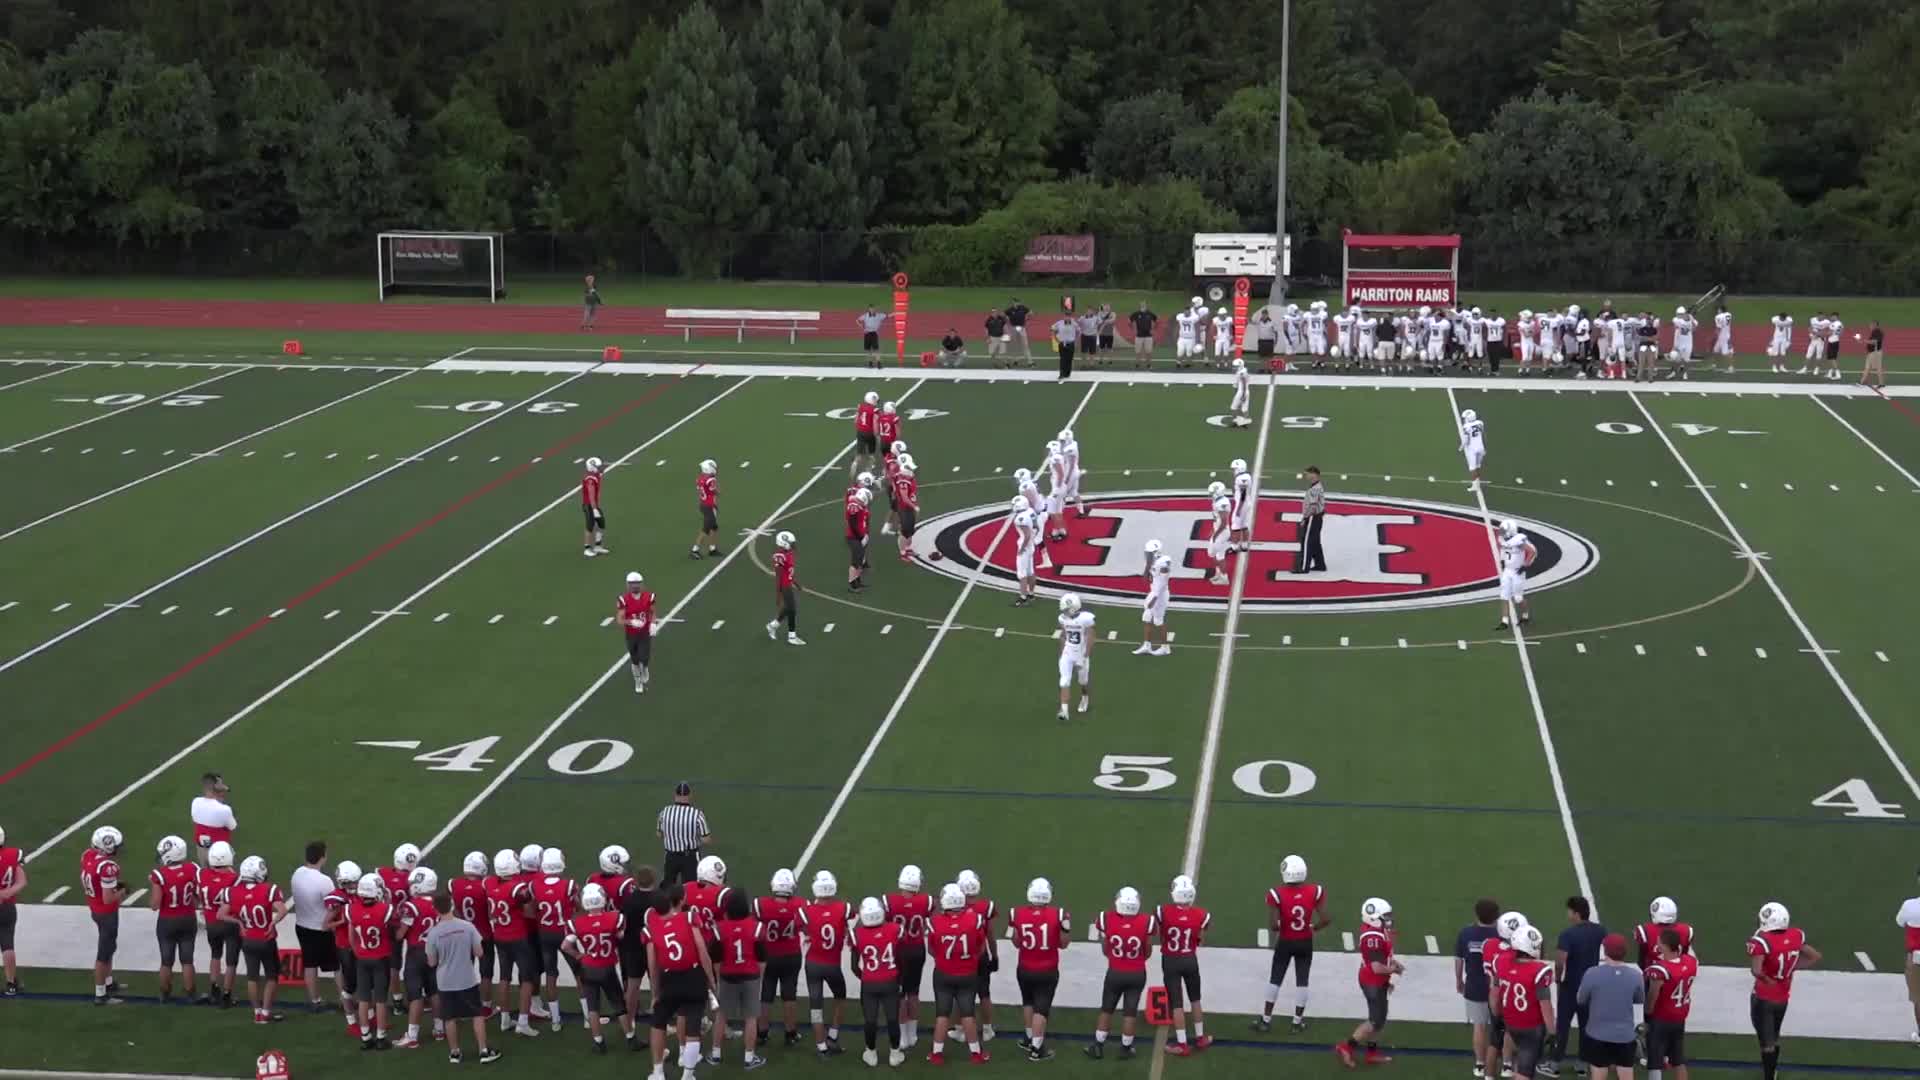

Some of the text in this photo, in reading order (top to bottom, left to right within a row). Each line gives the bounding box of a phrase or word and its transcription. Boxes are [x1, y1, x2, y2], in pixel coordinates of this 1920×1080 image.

[1351, 287, 1449, 302] HARRITON RAMS
[413, 736, 634, 775] 40
[1093, 754, 1317, 798] 50
[1811, 778, 1906, 818] 4
[169, 884, 193, 908] 16
[201, 886, 225, 911] 14
[462, 896, 475, 920] 6
[239, 905, 266, 929] 40
[538, 900, 566, 925] 21
[1290, 904, 1306, 931] 3
[354, 925, 380, 950] 13
[767, 919, 796, 941] 64
[820, 923, 836, 950] 9
[1020, 922, 1049, 950] 51
[1167, 926, 1193, 953] 31
[583, 932, 613, 958] 25
[664, 932, 682, 962] 5
[733, 938, 745, 964] 1
[863, 942, 897, 972] 34
[941, 933, 971, 960] 71
[1109, 935, 1142, 960] 33
[1775, 950, 1800, 980] 17
[1500, 978, 1528, 1012] 78
